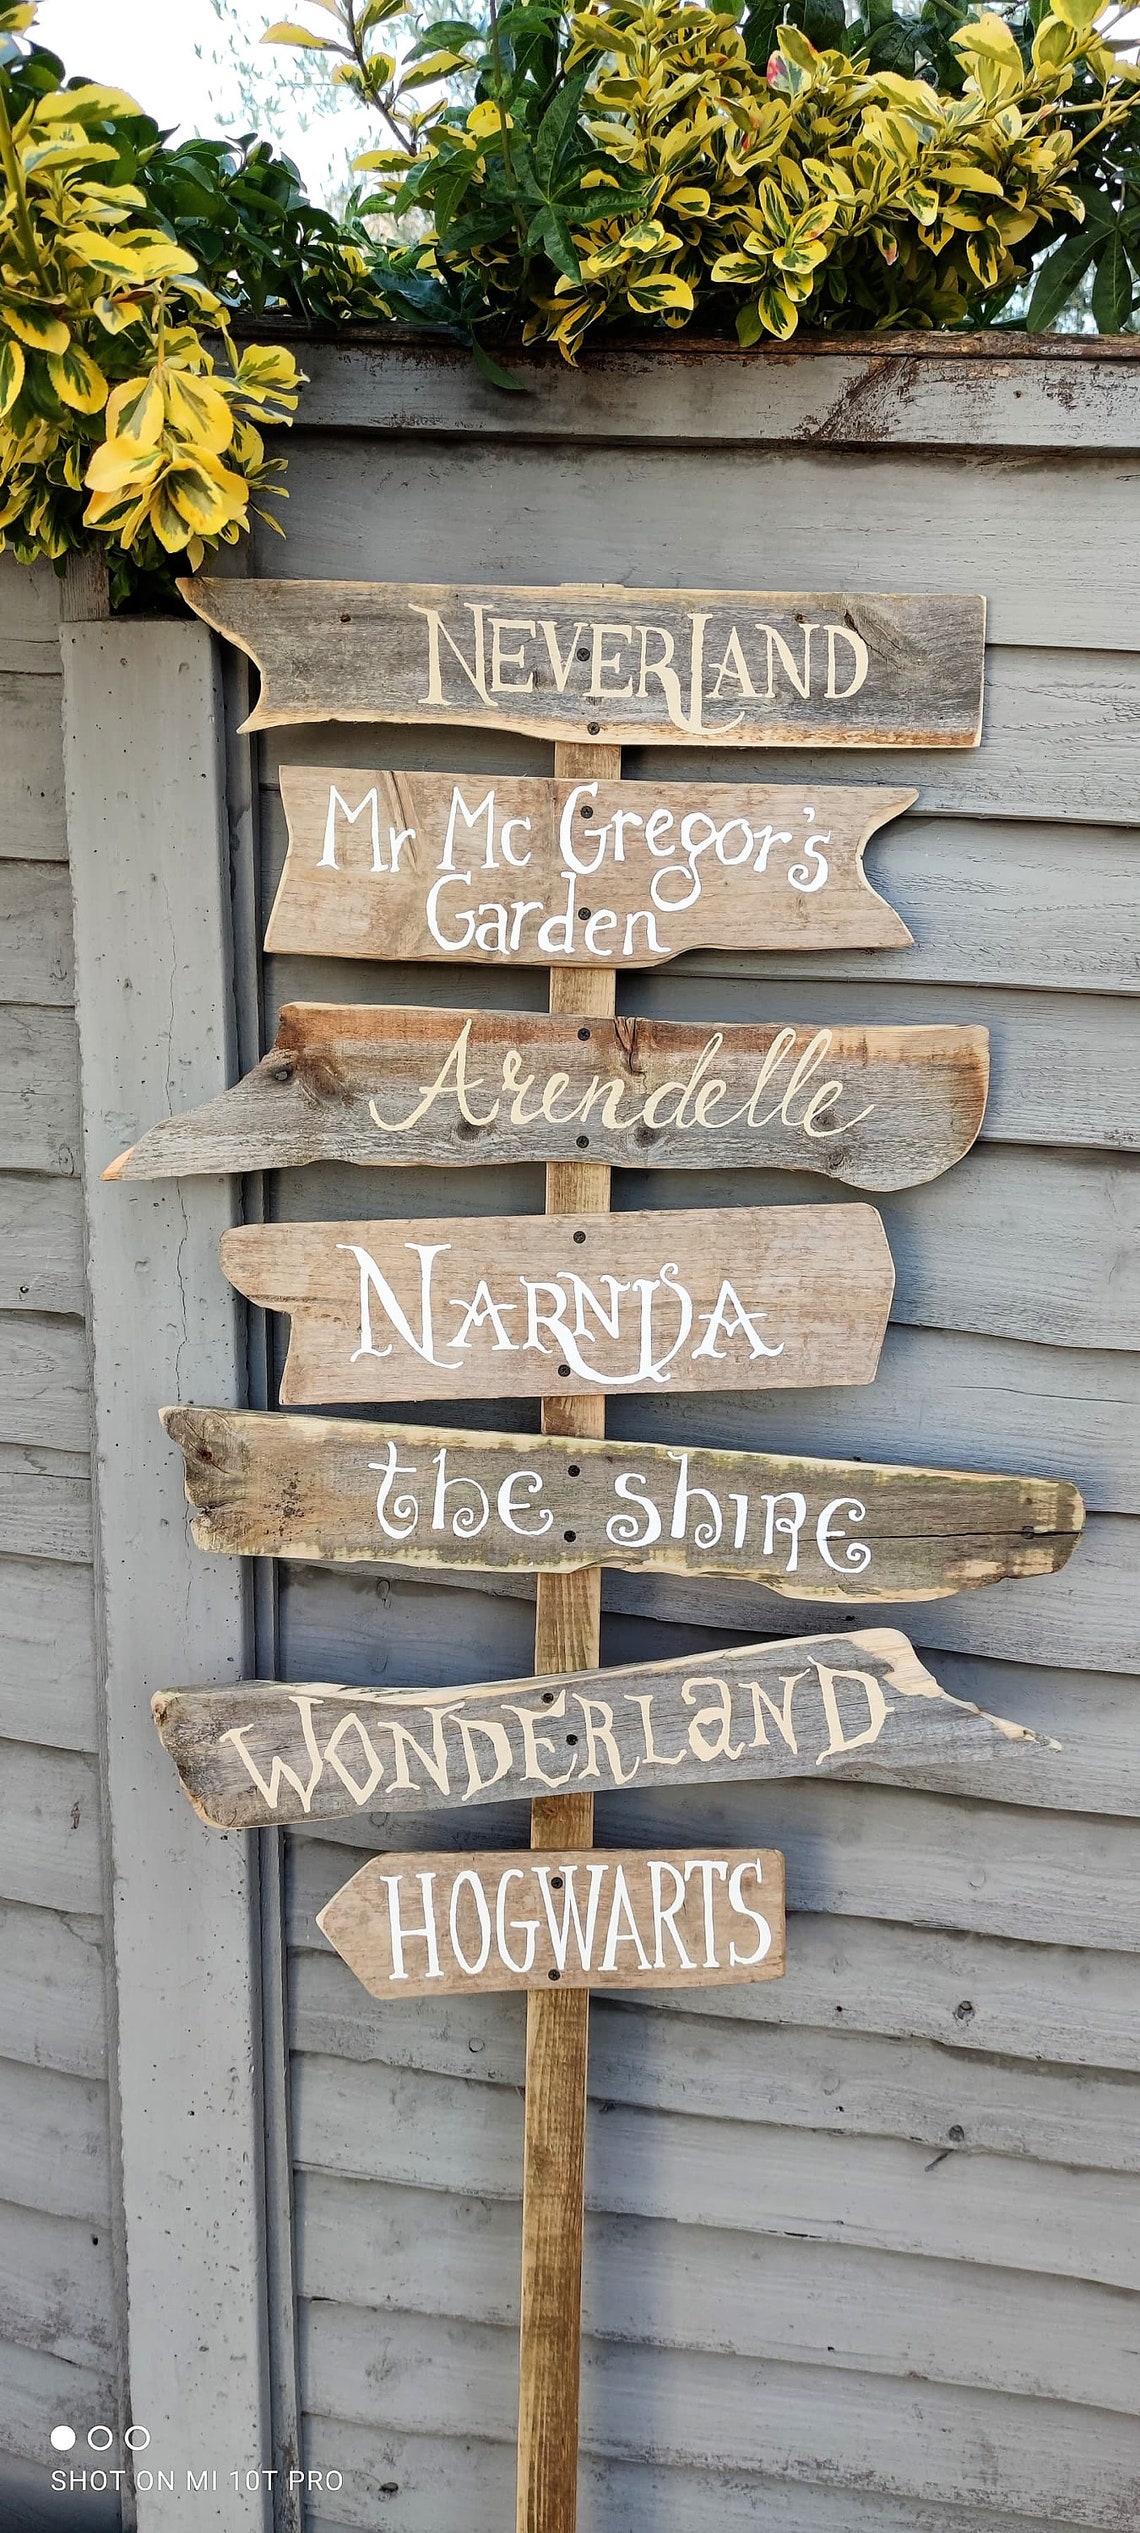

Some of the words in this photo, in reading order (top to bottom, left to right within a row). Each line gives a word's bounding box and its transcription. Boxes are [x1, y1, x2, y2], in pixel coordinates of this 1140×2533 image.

[408, 602, 870, 734] NEVERLAND
[317, 785, 415, 873] Mr
[437, 786, 532, 871] Mc
[560, 781, 832, 913] Gregor's
[426, 871, 672, 956] Garden
[368, 1018, 877, 1138] Arendelle
[336, 1242, 785, 1386] NARNIA
[380, 1858, 773, 1980] HOGWARTS
